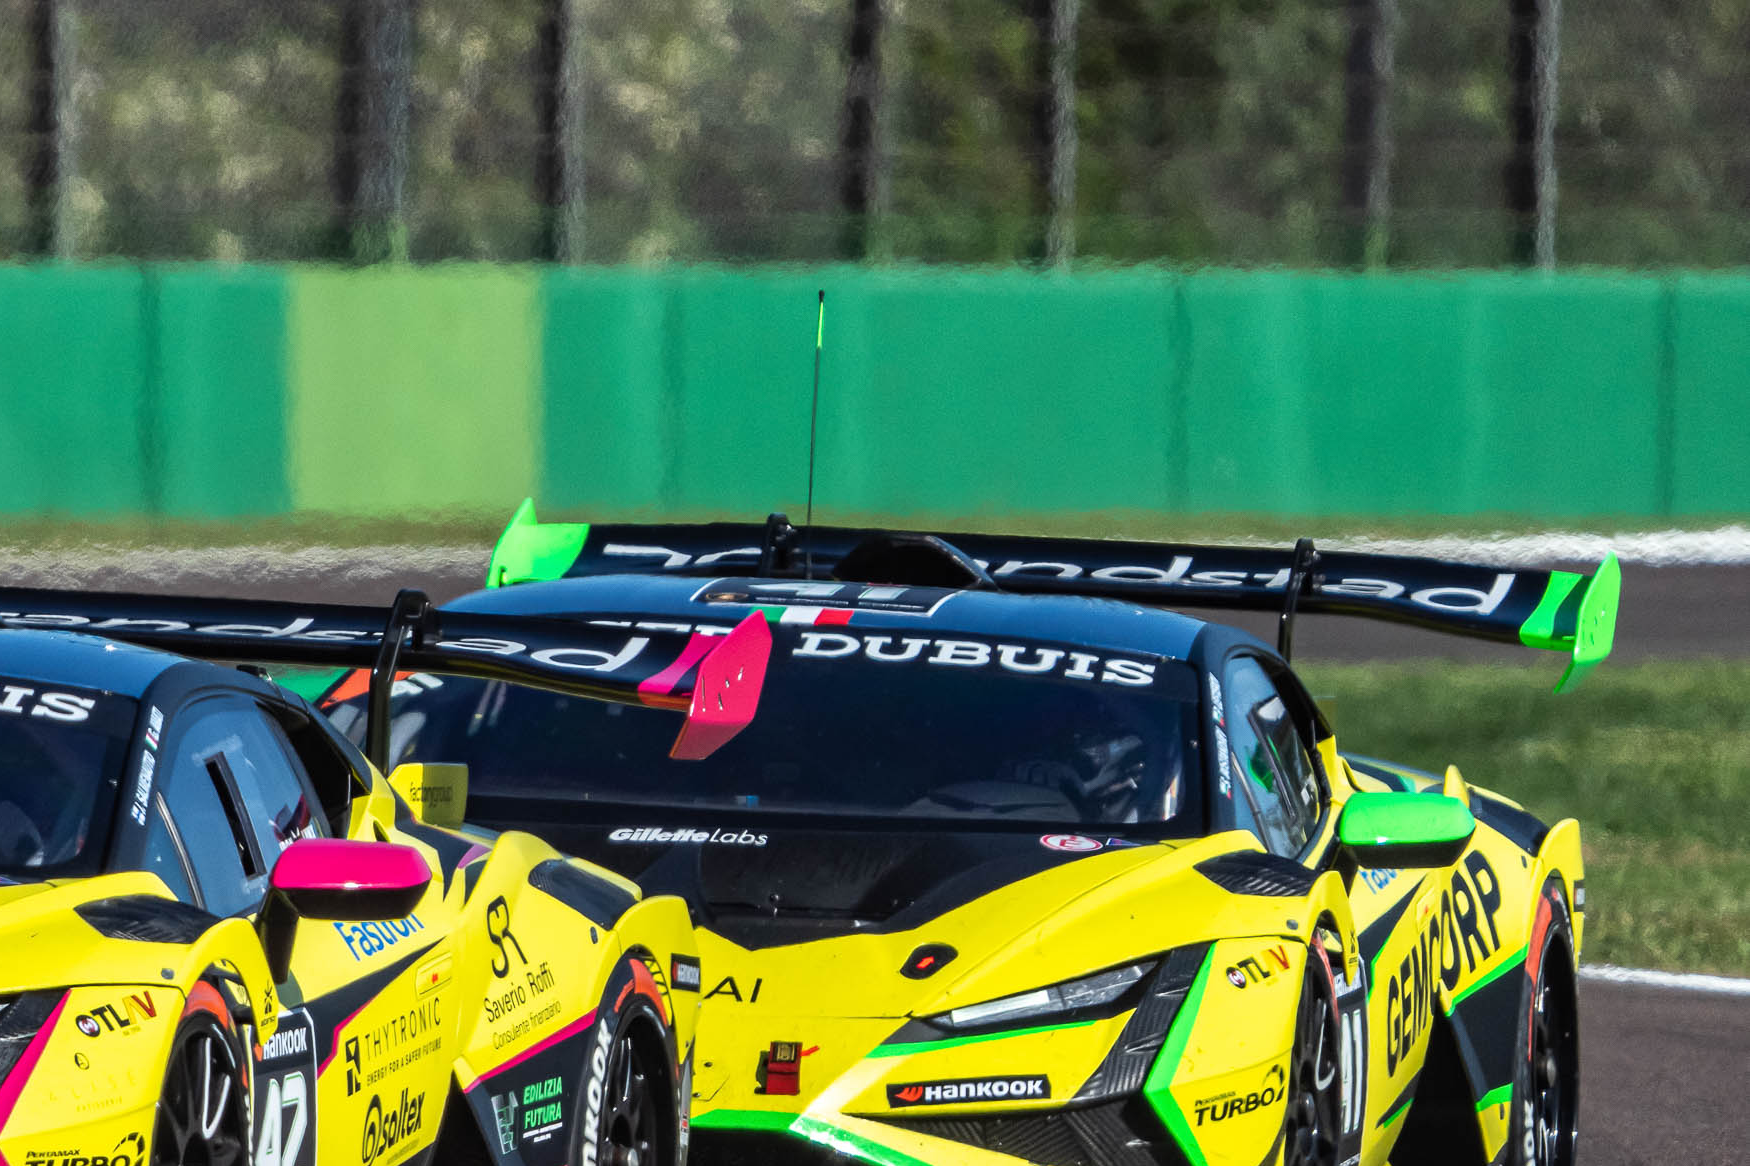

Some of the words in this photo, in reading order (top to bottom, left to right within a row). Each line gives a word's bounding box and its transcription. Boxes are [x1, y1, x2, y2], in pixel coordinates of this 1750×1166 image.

[974, 556, 1517, 616] ndstad
[792, 632, 1155, 686] DUBUIS
[333, 912, 425, 962] Fastron
[1387, 850, 1502, 1079] GEMCORP
[483, 981, 527, 1024] Saverio
[364, 997, 442, 1061] THYTRONIC
[523, 1076, 563, 1105] EDILIZIA
[524, 1101, 562, 1130] FUTURA
[1195, 1087, 1276, 1127] TURBO
